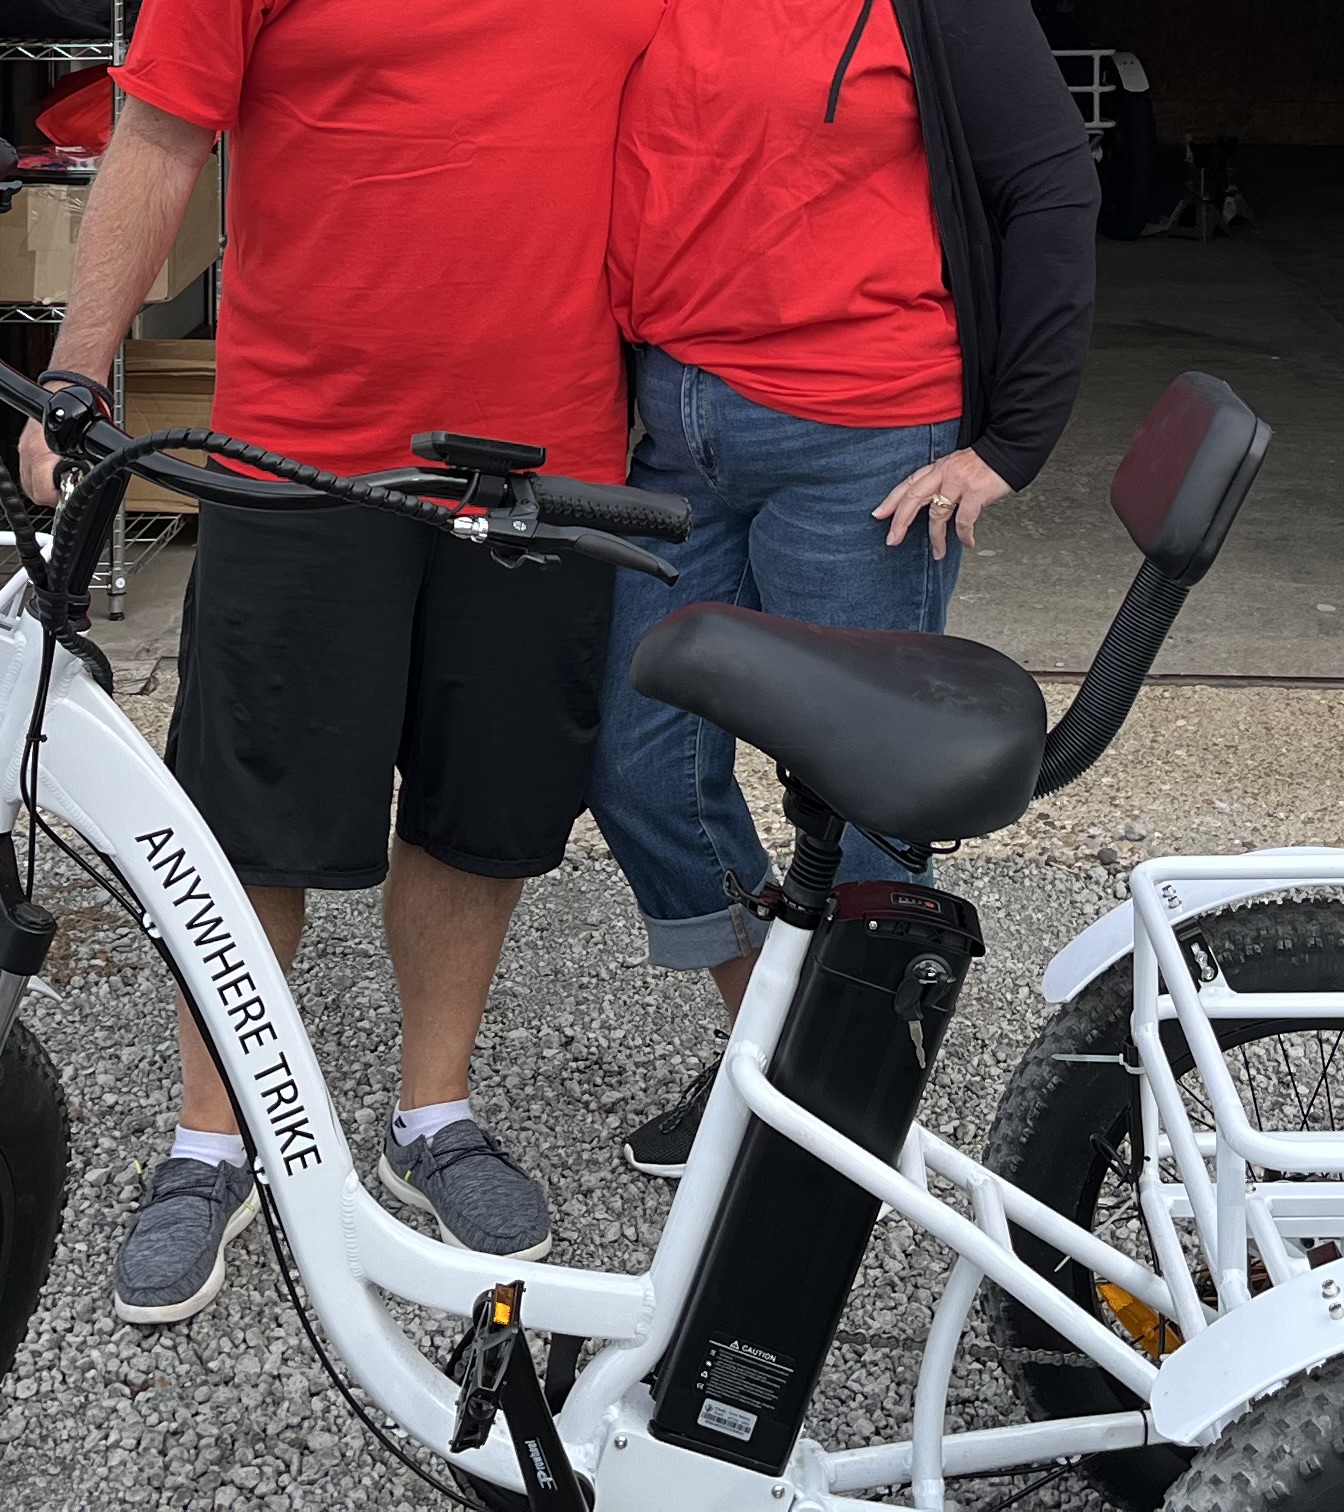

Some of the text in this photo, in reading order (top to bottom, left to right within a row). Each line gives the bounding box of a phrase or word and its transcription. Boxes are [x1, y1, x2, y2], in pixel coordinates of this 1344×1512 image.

[134, 826, 323, 1178] ANYWHERE TRIKE
[742, 1344, 777, 1363] CAUTION
